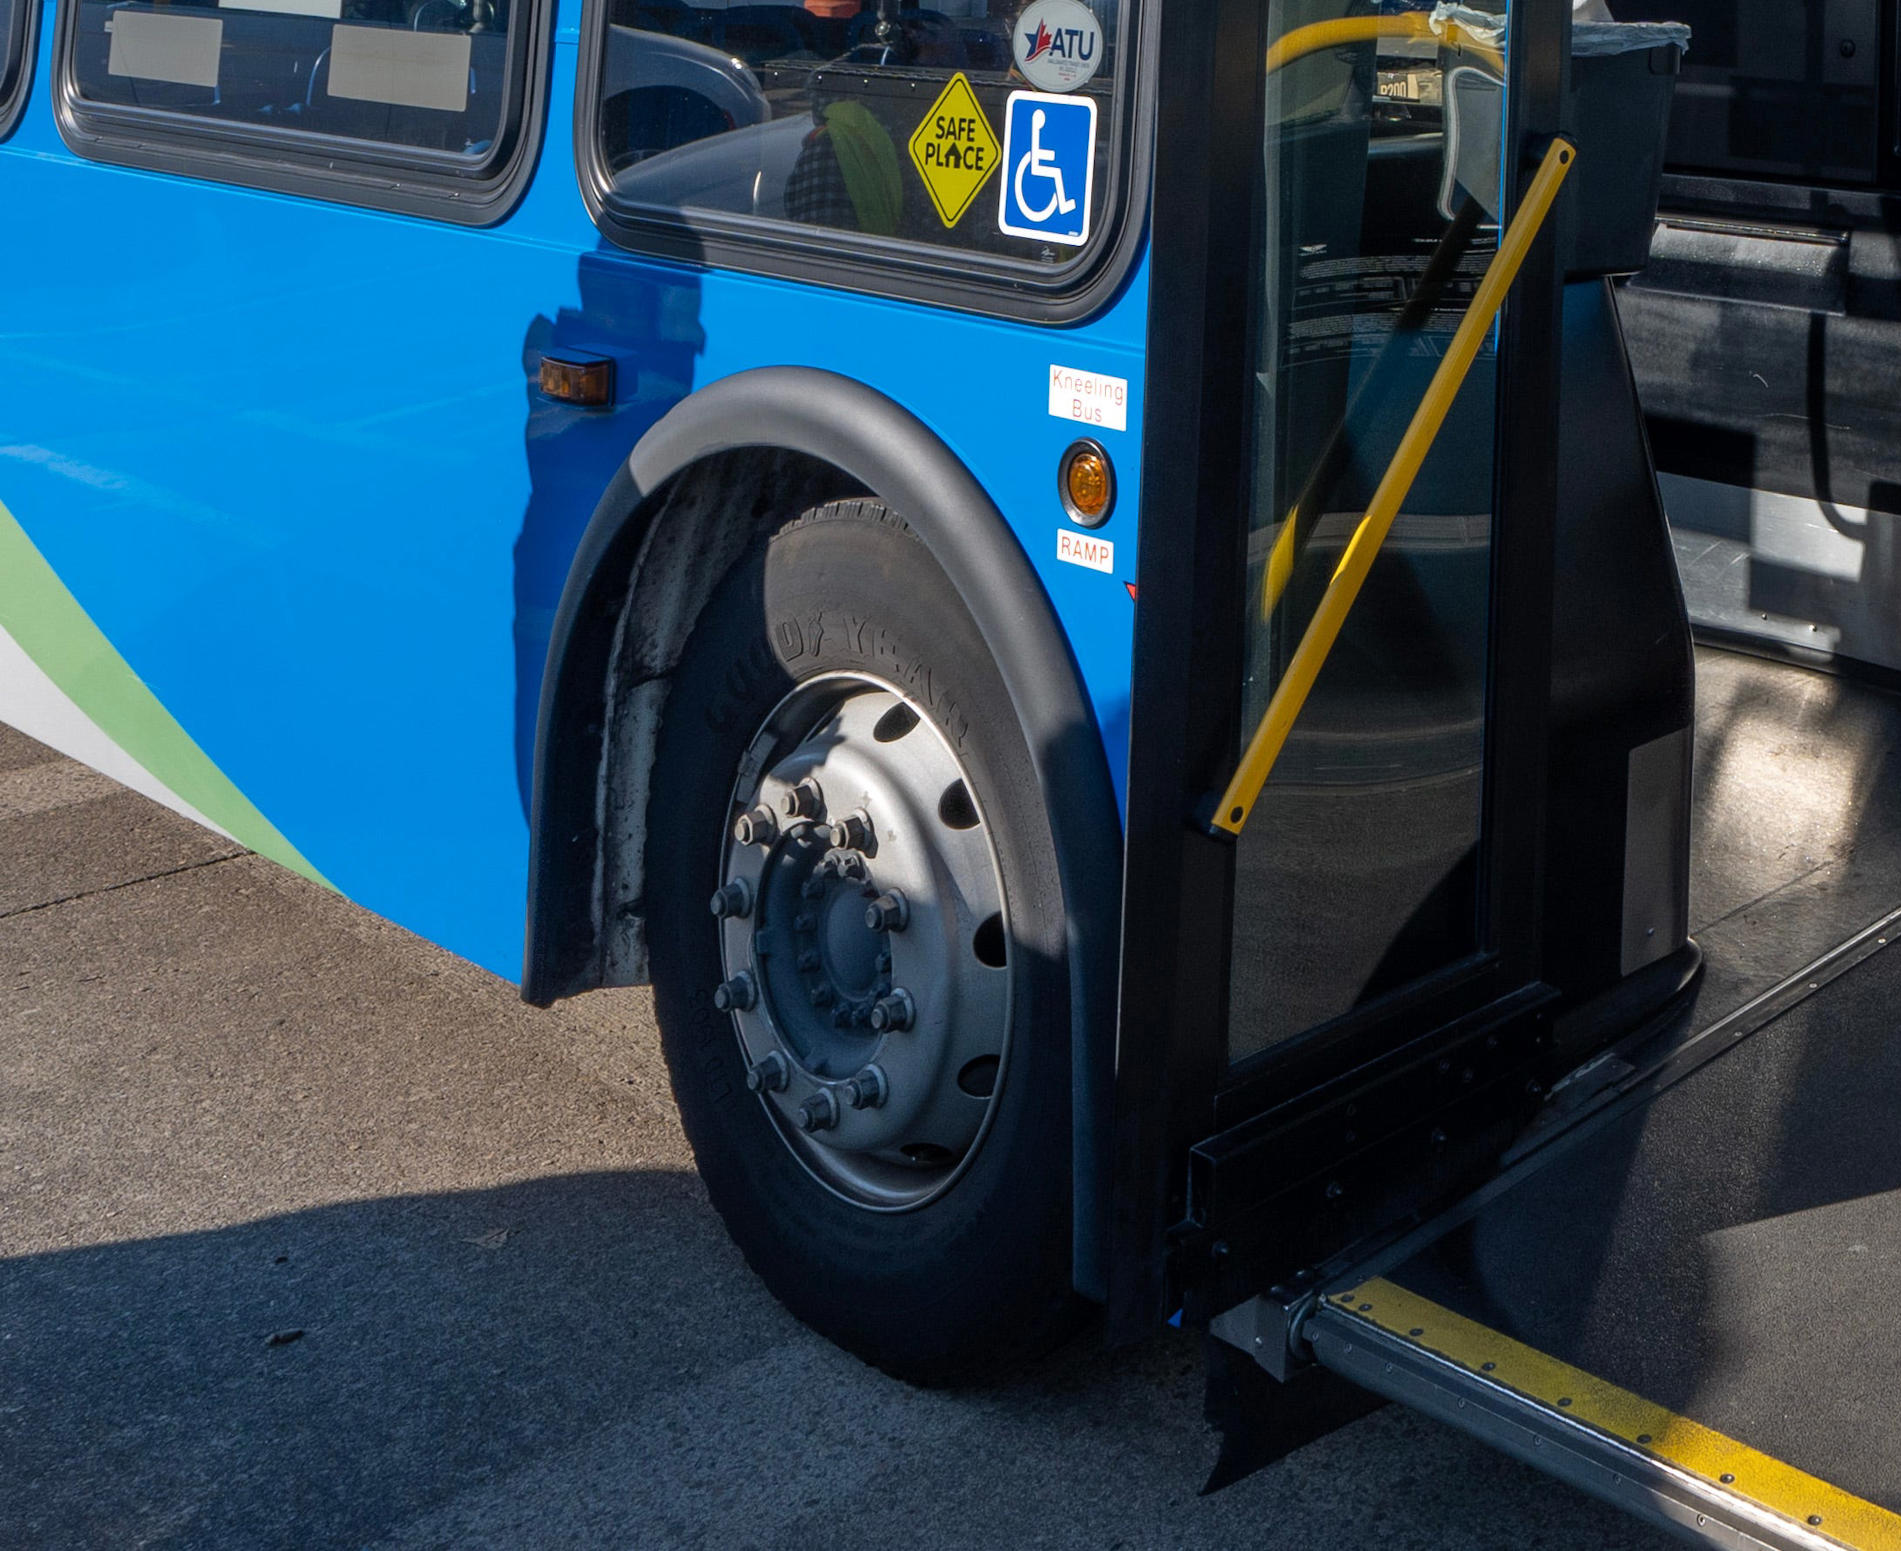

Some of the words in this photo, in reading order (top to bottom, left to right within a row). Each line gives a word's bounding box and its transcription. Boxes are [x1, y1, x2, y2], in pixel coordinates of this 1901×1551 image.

[1048, 27, 1094, 61] ATU
[935, 115, 976, 142] SAFE
[1053, 369, 1124, 406] Kneeling
[1072, 399, 1103, 423] Bus
[1061, 536, 1110, 565] RAMP
